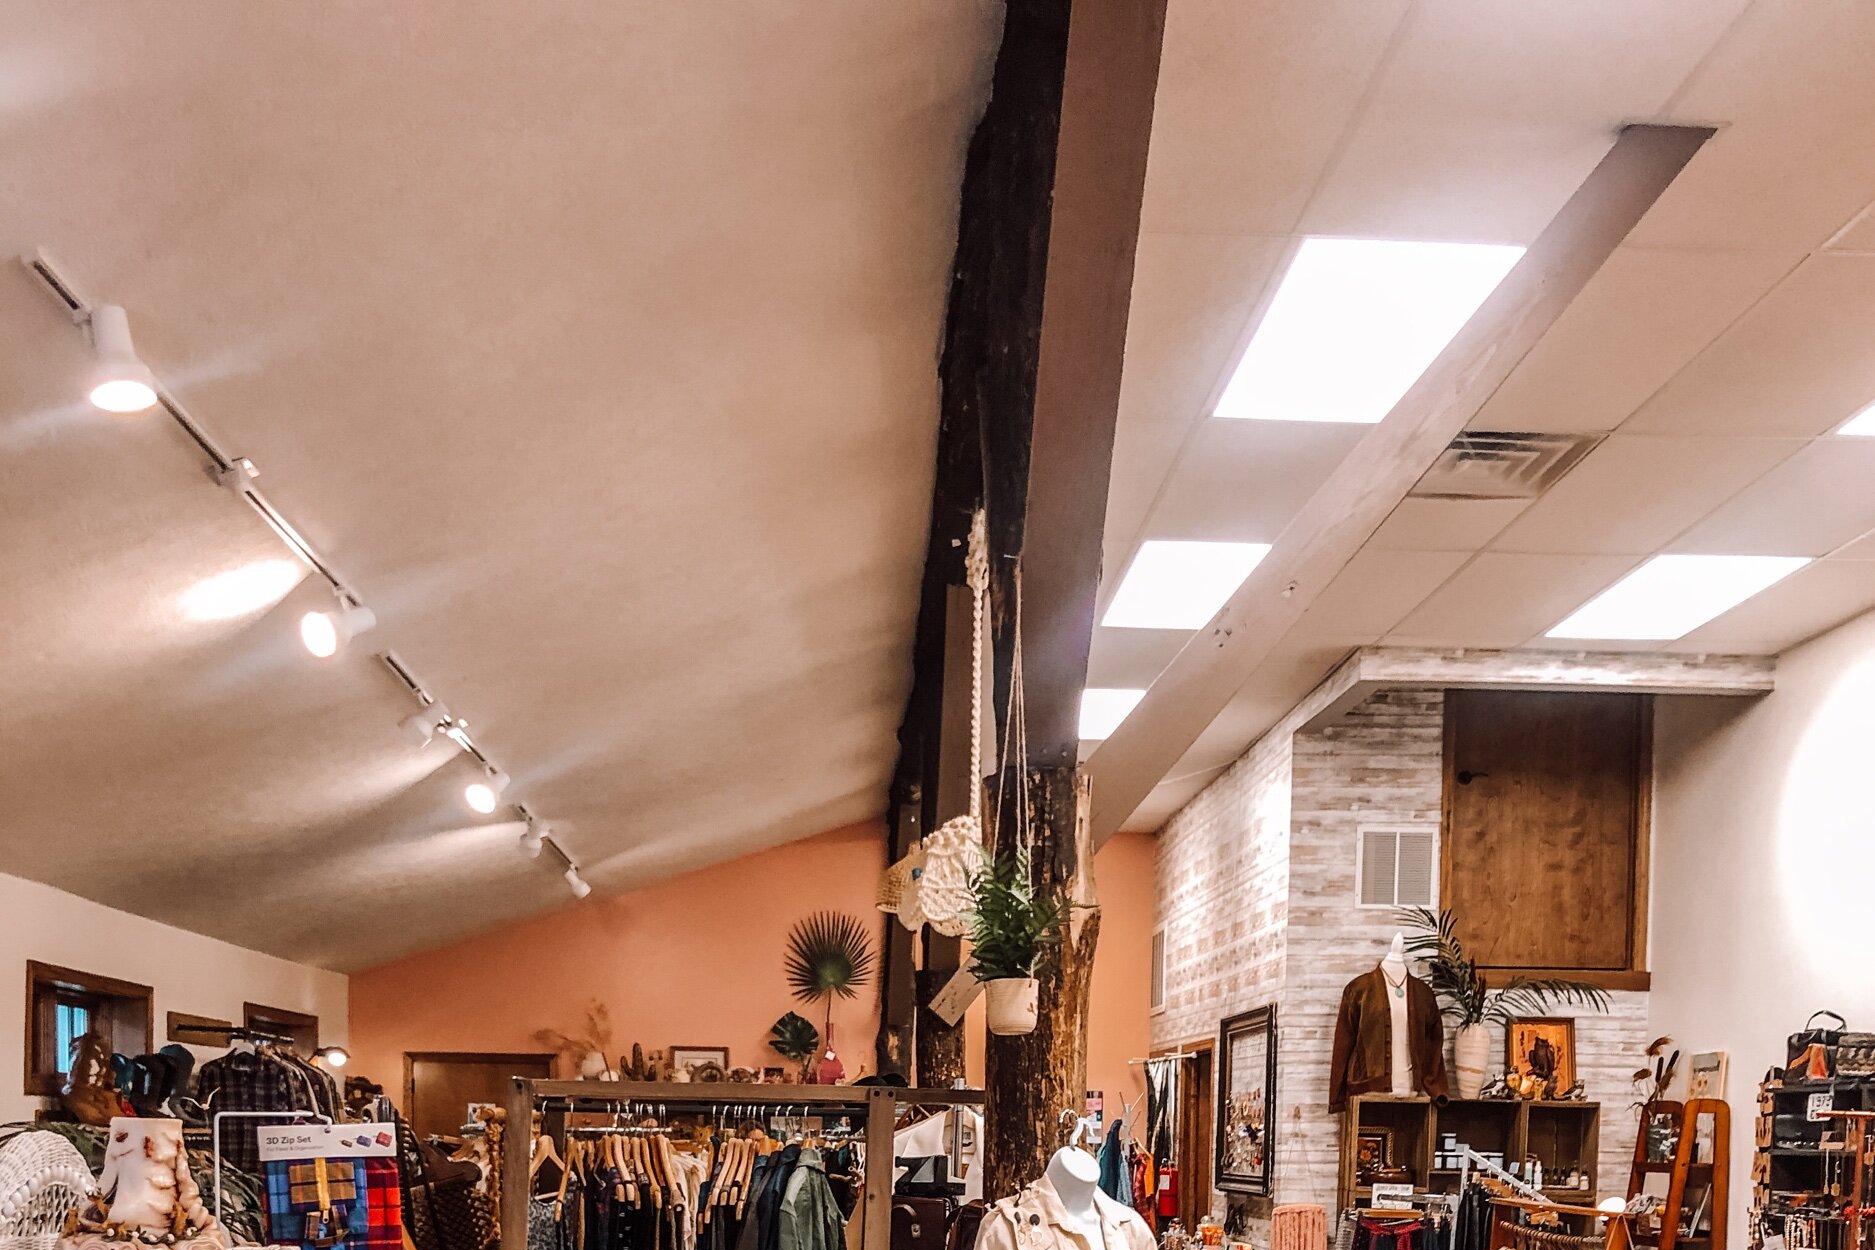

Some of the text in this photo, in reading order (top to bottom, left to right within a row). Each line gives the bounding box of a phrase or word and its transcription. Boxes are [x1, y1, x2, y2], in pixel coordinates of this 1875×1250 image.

[266, 1135, 312, 1145] 3D Zip Set
